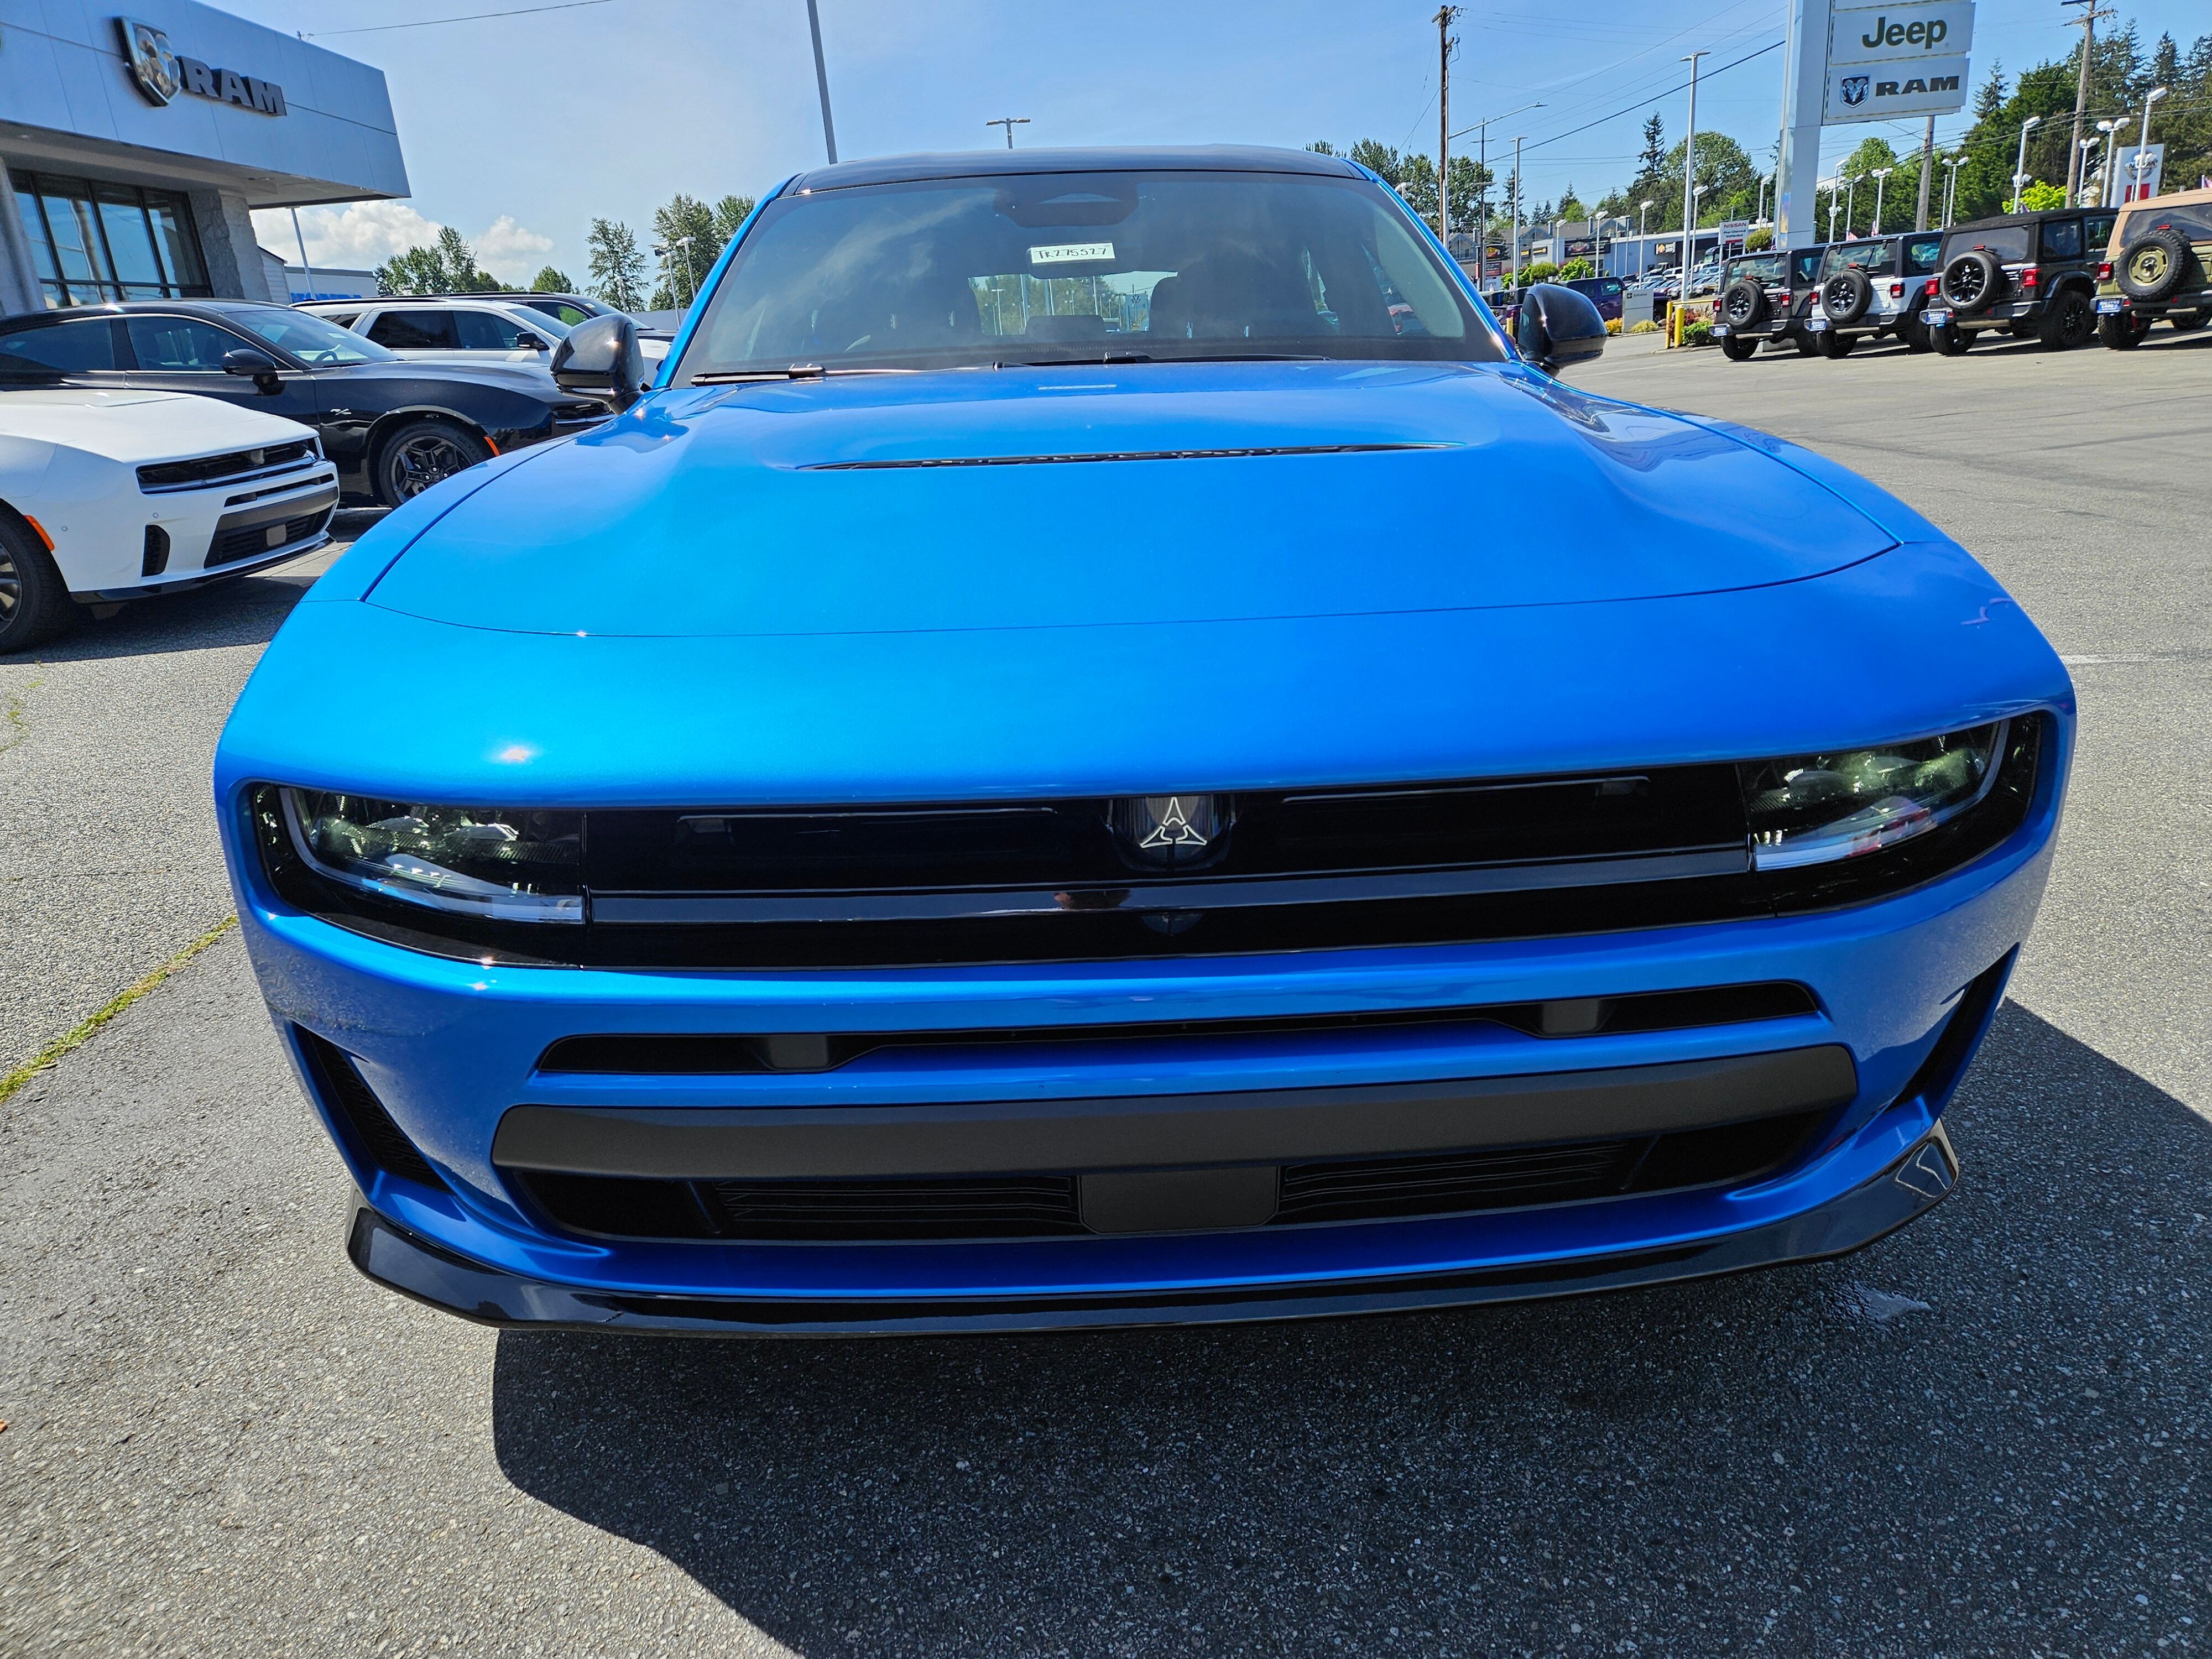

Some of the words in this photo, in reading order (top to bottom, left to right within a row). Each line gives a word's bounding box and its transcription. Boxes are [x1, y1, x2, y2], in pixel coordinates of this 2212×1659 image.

[1862, 17, 1947, 49] Jeep
[175, 55, 287, 116] RAM
[1876, 76, 1959, 96] RAM
